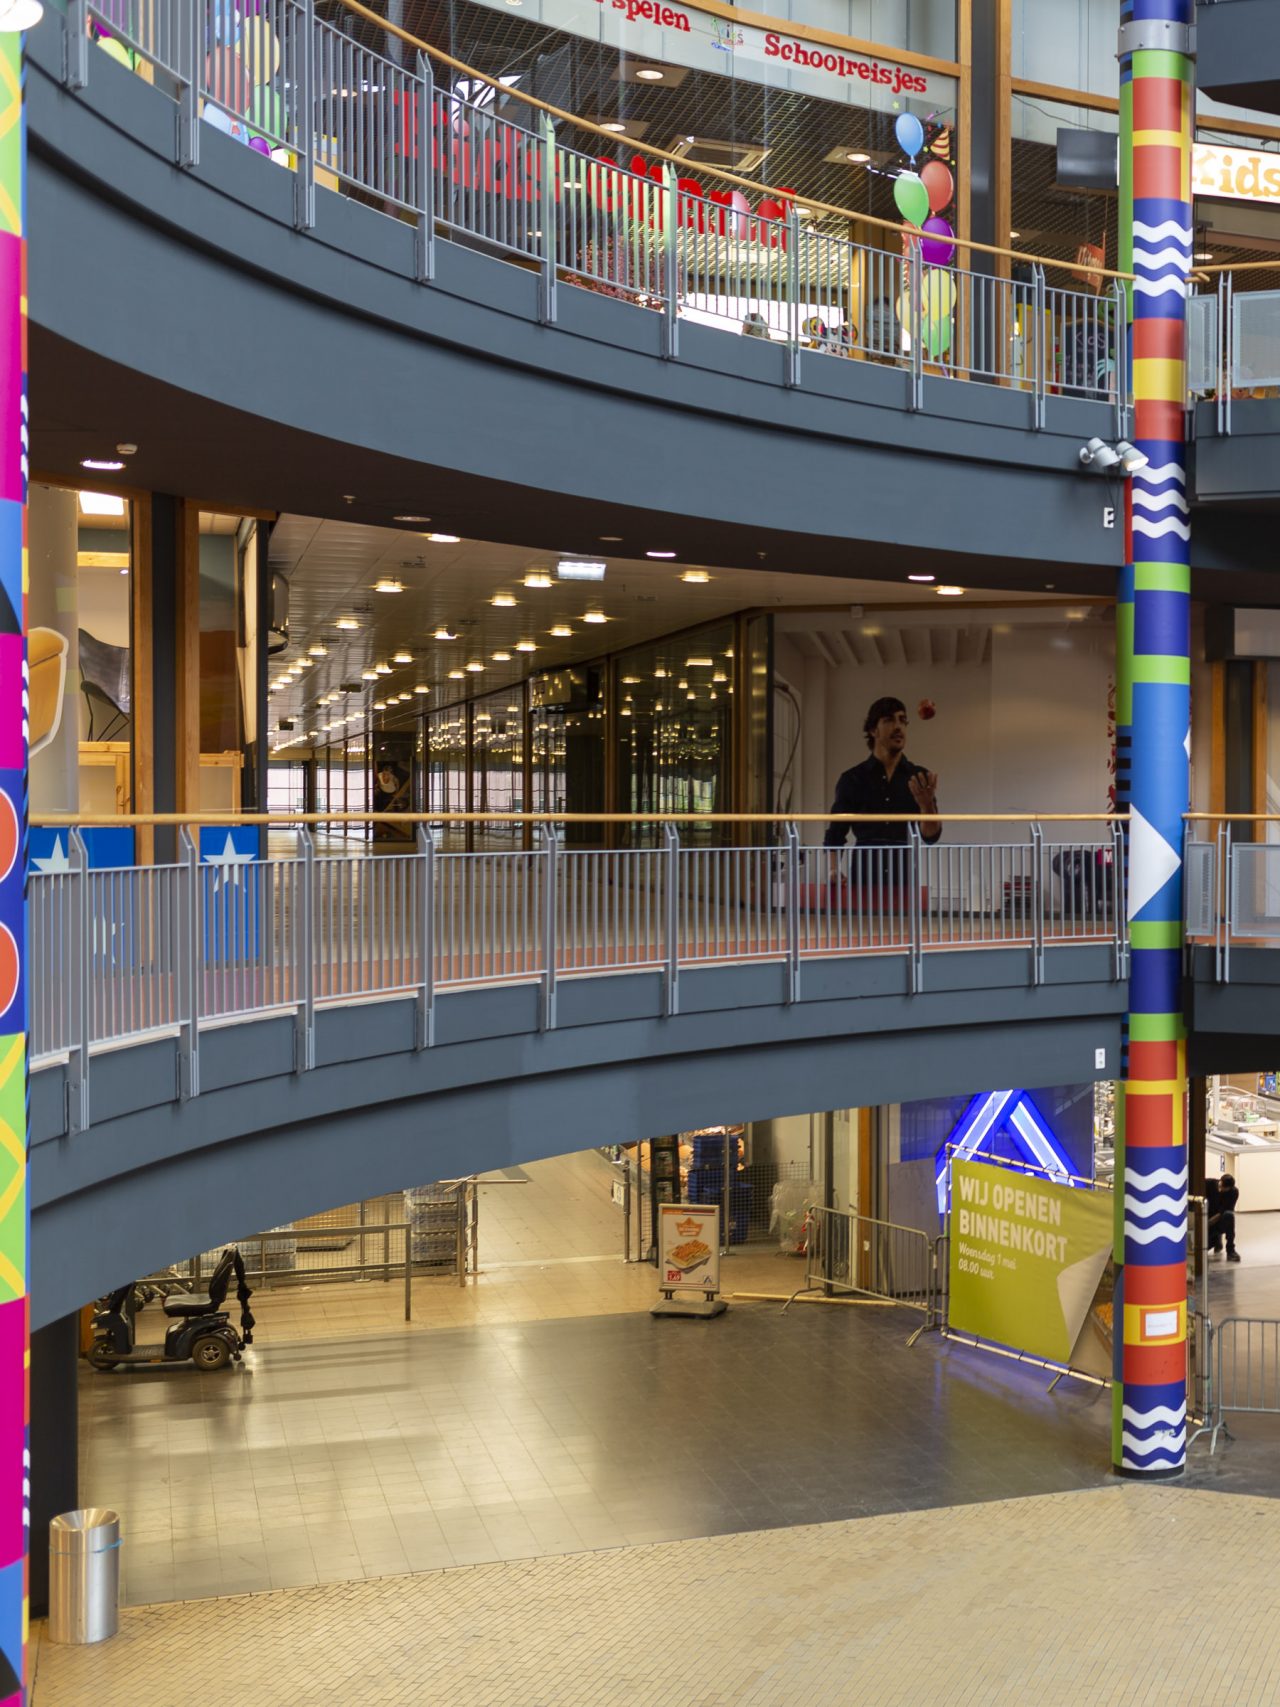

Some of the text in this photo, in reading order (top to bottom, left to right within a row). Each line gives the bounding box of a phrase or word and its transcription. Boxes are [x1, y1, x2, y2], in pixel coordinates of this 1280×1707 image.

[764, 32, 927, 93] Schoolreisjes
[959, 1175, 1062, 1226] WIJ OPENEN
[958, 1242, 996, 1266] Woensdag
[959, 1209, 1068, 1264] BINNENKORT
